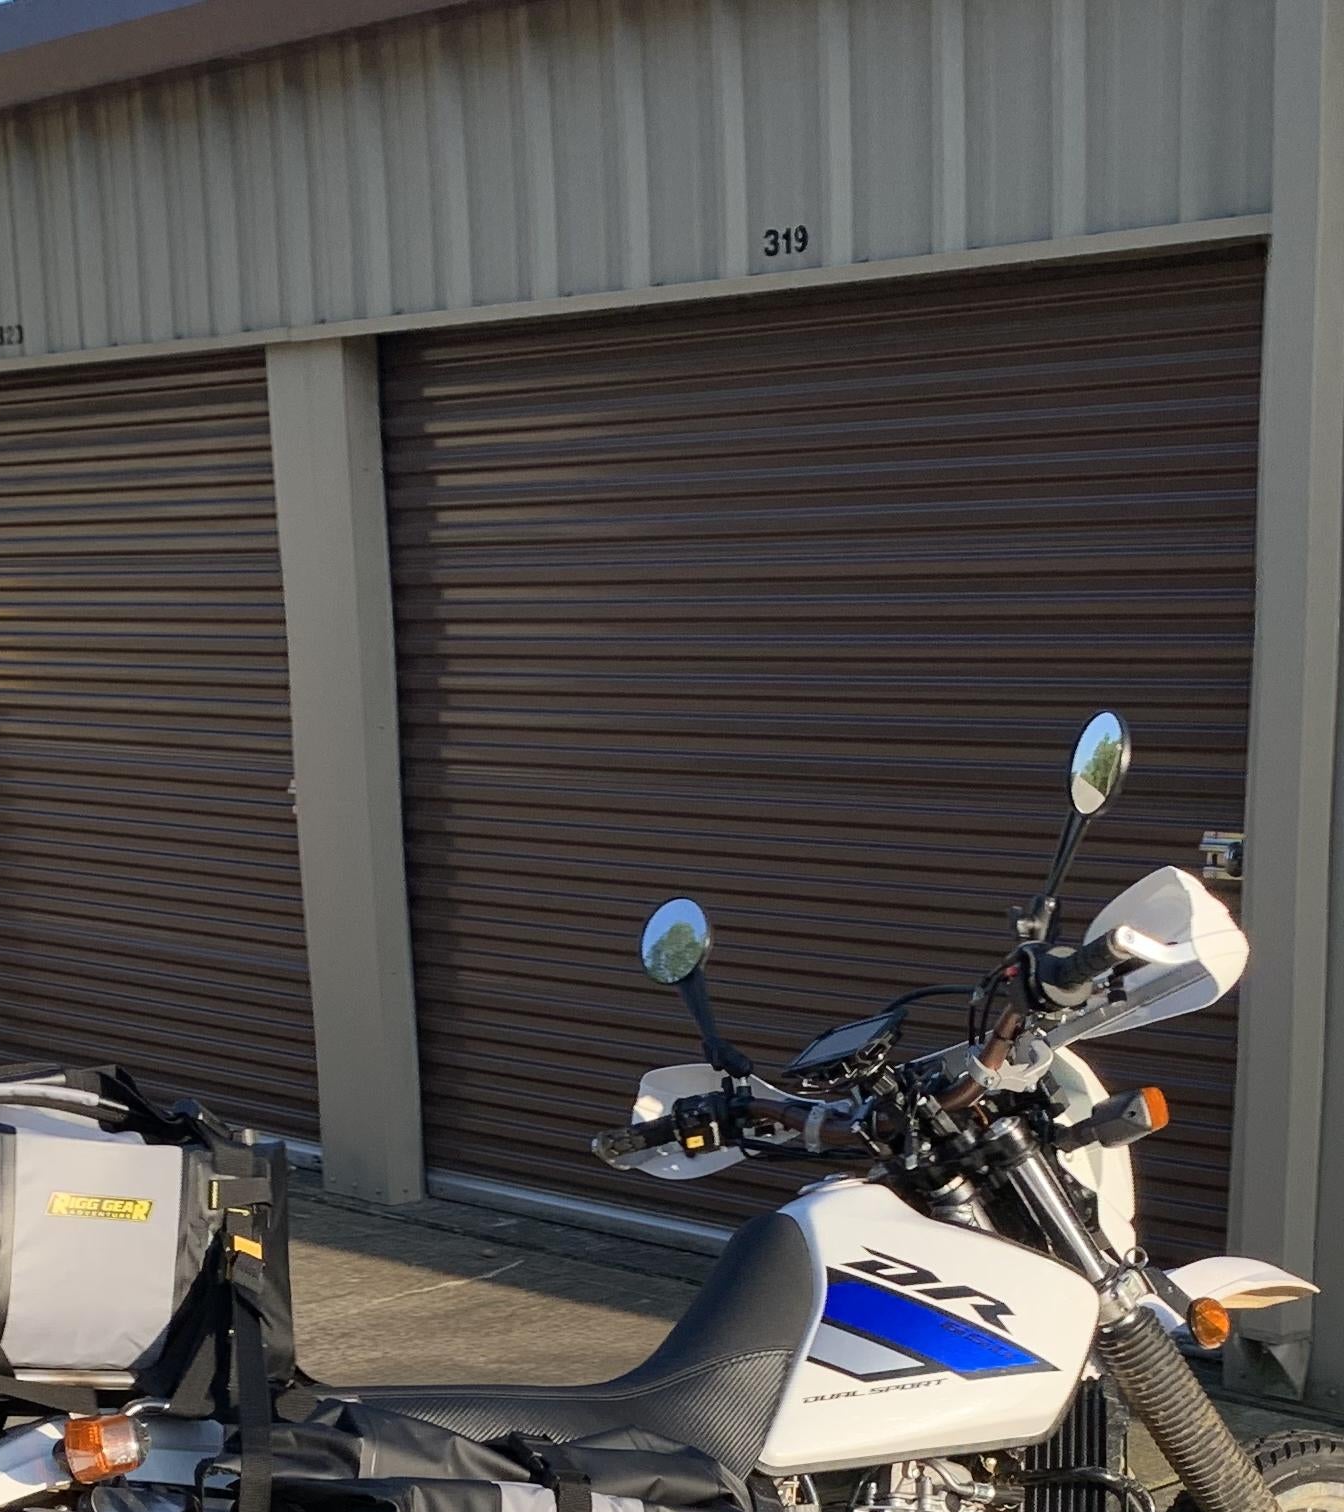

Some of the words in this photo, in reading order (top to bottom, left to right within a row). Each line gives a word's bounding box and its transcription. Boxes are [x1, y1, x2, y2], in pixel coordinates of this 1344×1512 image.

[763, 225, 808, 256] 319
[51, 1193, 101, 1215] RIGG
[101, 1199, 150, 1221] GEAR
[840, 1245, 1017, 1336] DR
[802, 1390, 865, 1404] DUAL
[868, 1378, 949, 1395] SPORT
